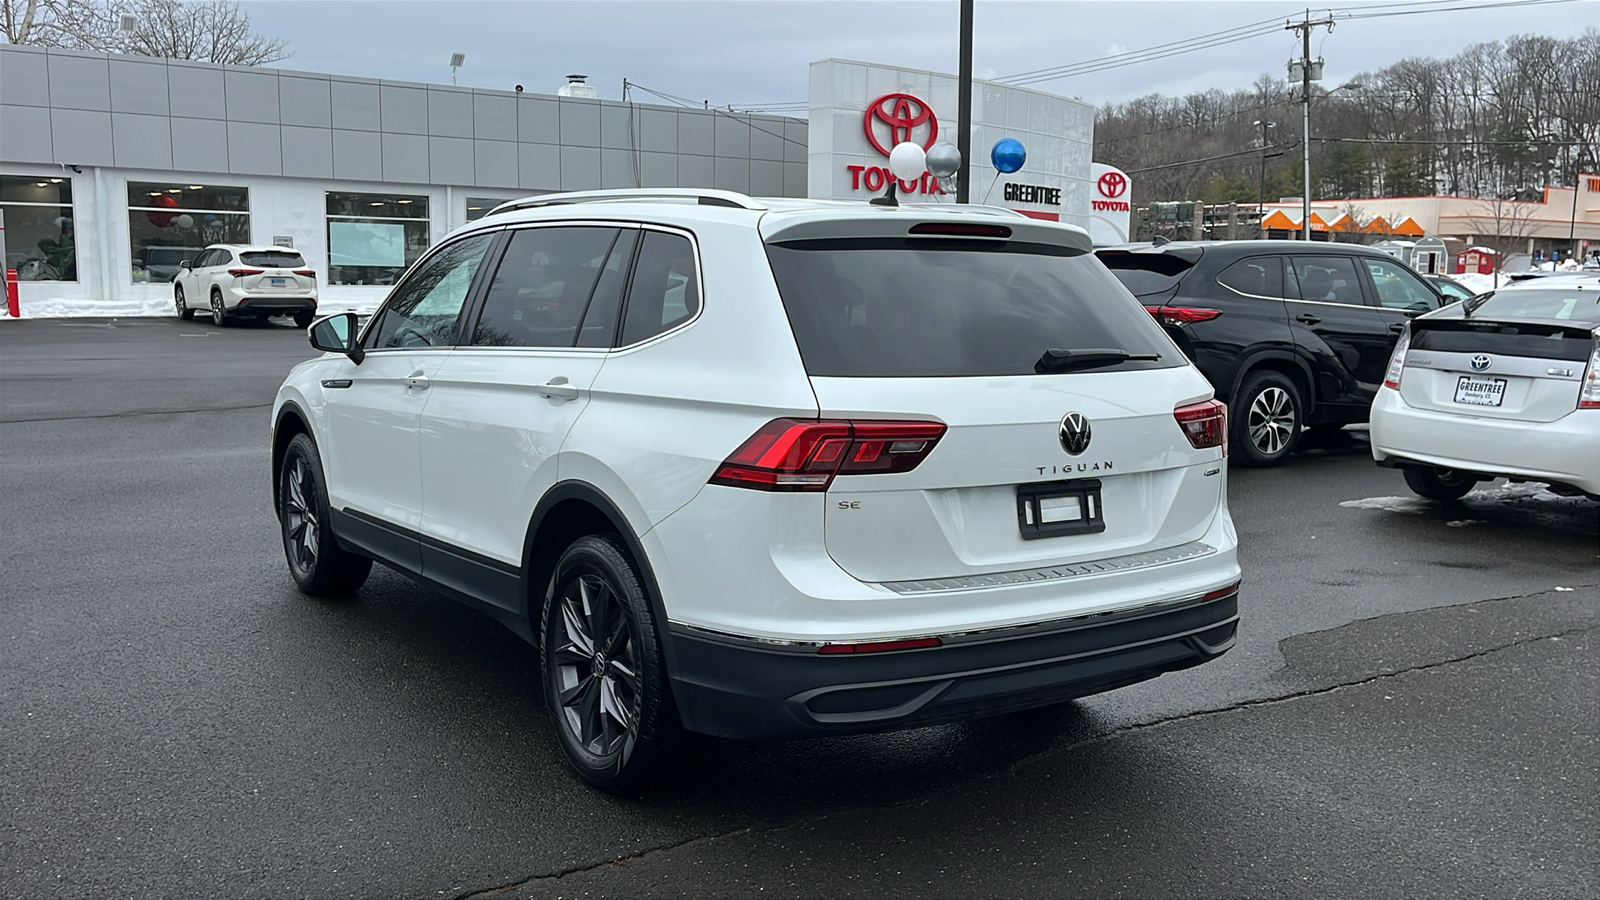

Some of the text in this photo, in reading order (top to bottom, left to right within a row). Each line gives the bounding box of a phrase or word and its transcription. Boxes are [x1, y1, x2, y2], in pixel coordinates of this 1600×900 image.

[1004, 182, 1061, 205] GREENTREE
[1091, 200, 1129, 212] TOYOTA
[1460, 381, 1502, 394] GREENTREE
[1036, 461, 1113, 475] TIGUAN
[838, 501, 861, 509] SE
